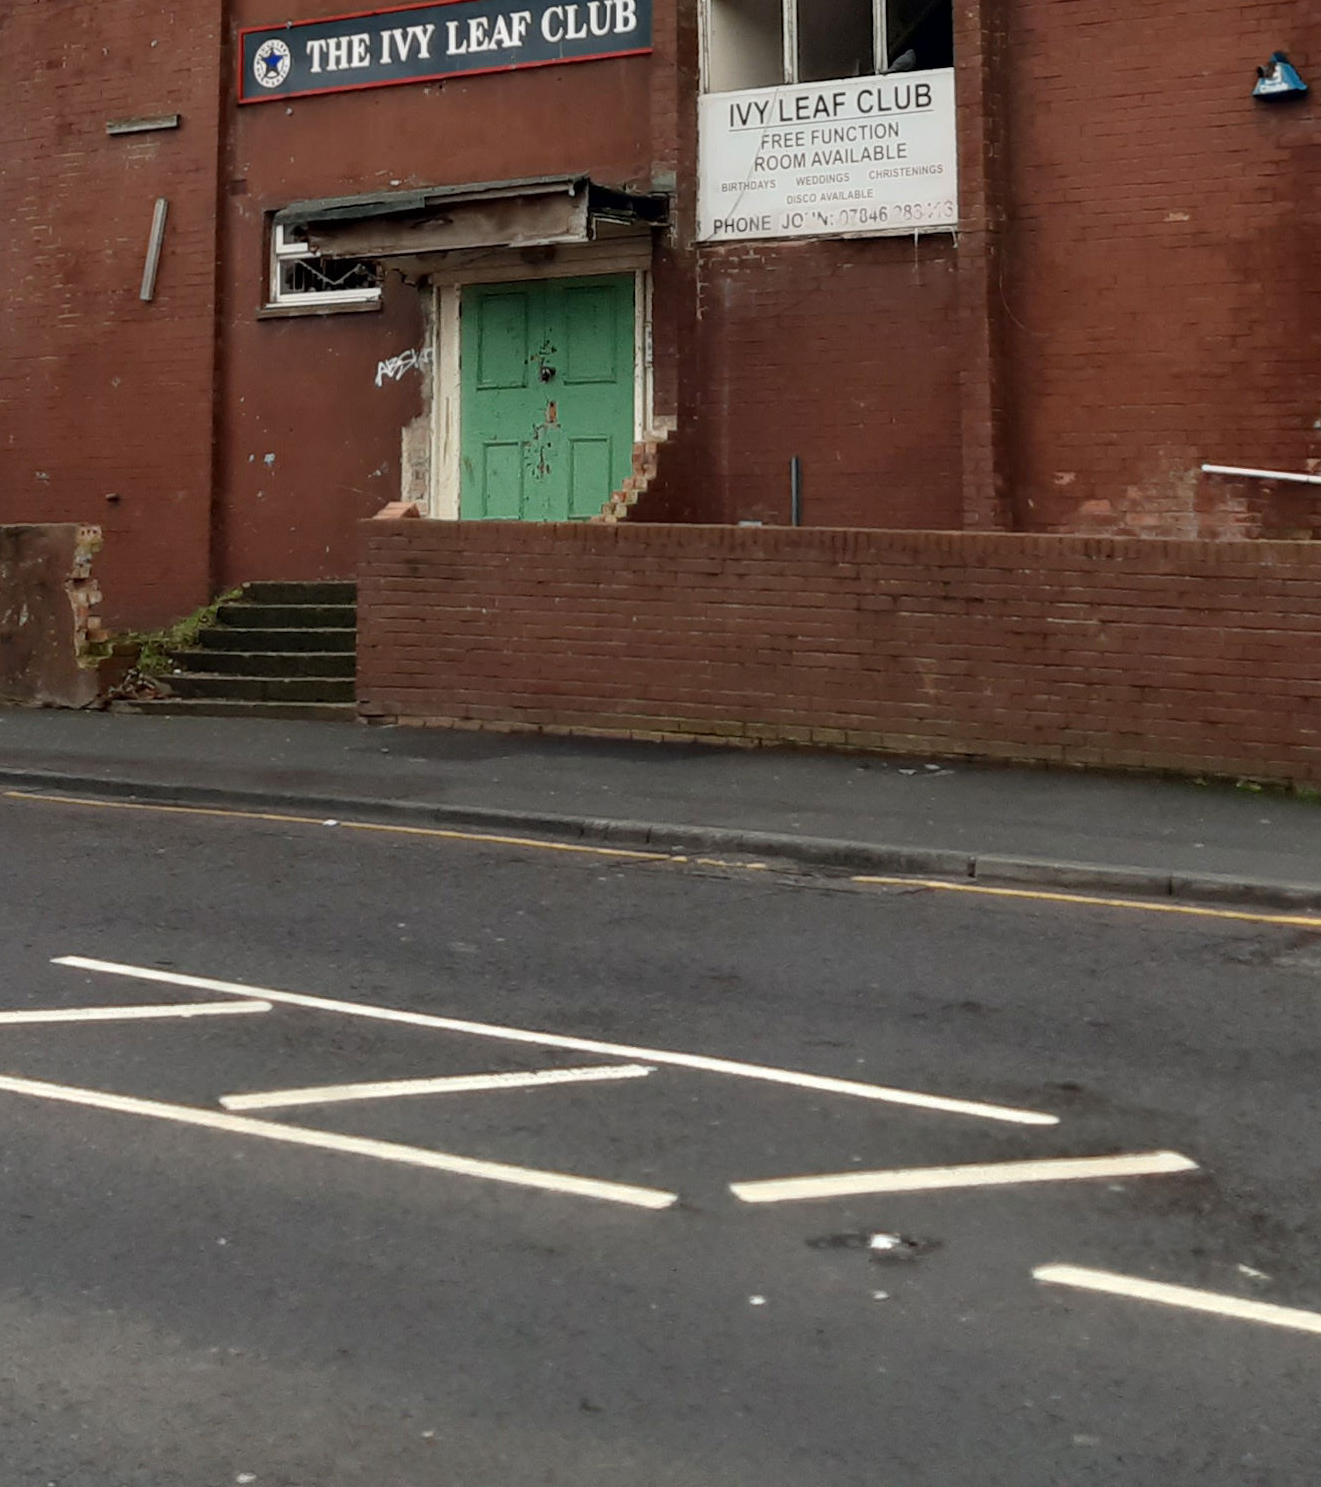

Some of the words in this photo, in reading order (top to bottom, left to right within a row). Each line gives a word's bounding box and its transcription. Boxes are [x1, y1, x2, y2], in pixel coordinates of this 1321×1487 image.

[306, 33, 371, 74] THE
[379, 24, 436, 65] IVY
[446, 10, 532, 55] LEAF
[730, 100, 769, 127] IVY
[779, 92, 846, 122] LEAF
[857, 83, 932, 113] CLUB
[761, 131, 805, 150] FREE
[811, 121, 899, 145] FUNCTION
[754, 153, 806, 172] ROOM
[811, 143, 907, 167] AVAILABLE
[721, 179, 776, 193] BIRTHDAYS
[795, 172, 850, 187] WEDDINGS
[868, 164, 944, 180] CHRISTENINGS
[786, 193, 817, 205] DISCO
[820, 188, 874, 202] AVAILABLE
[713, 215, 772, 235] PHONE
